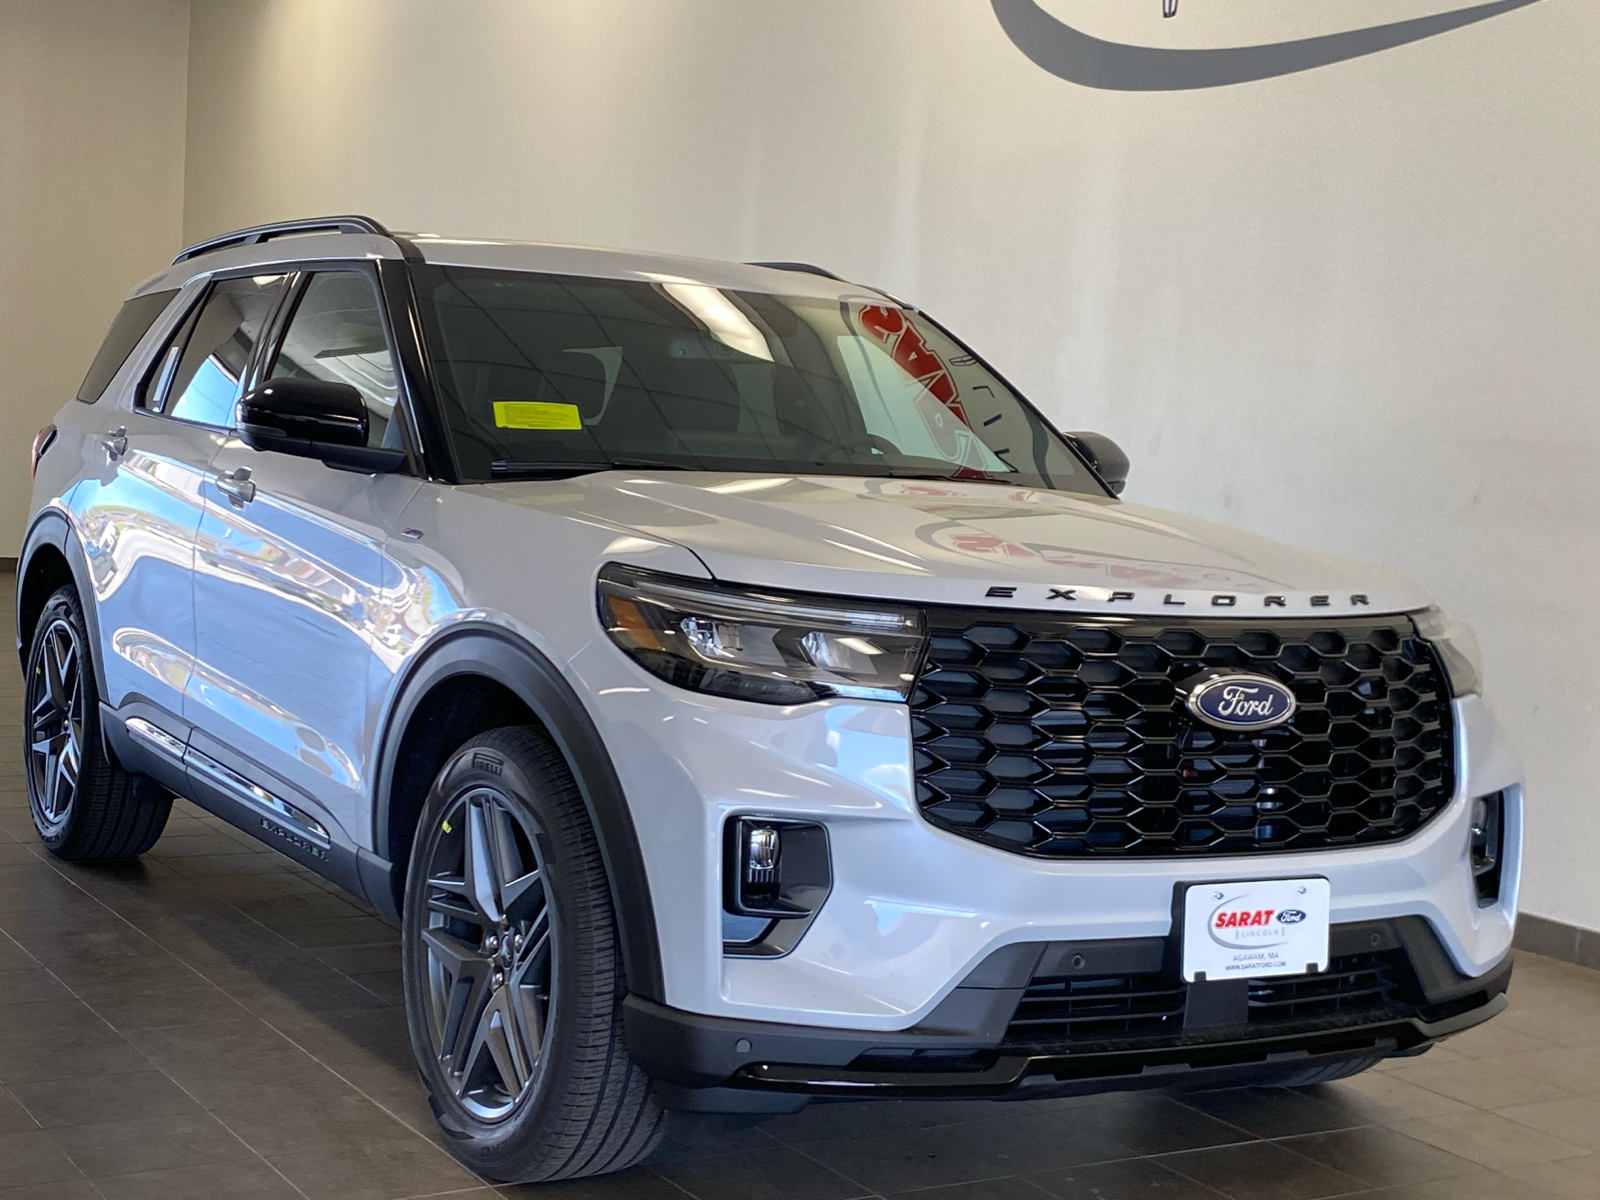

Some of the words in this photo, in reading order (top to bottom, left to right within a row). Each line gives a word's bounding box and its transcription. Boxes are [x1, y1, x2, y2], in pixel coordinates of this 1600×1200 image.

[985, 585, 1370, 607] EXPLORER
[1218, 685, 1274, 717] Ford
[471, 752, 505, 776] PIRELLI
[1214, 909, 1275, 929] SARAT
[1279, 910, 1303, 922] Ford
[1241, 929, 1279, 938] LINCOLN
